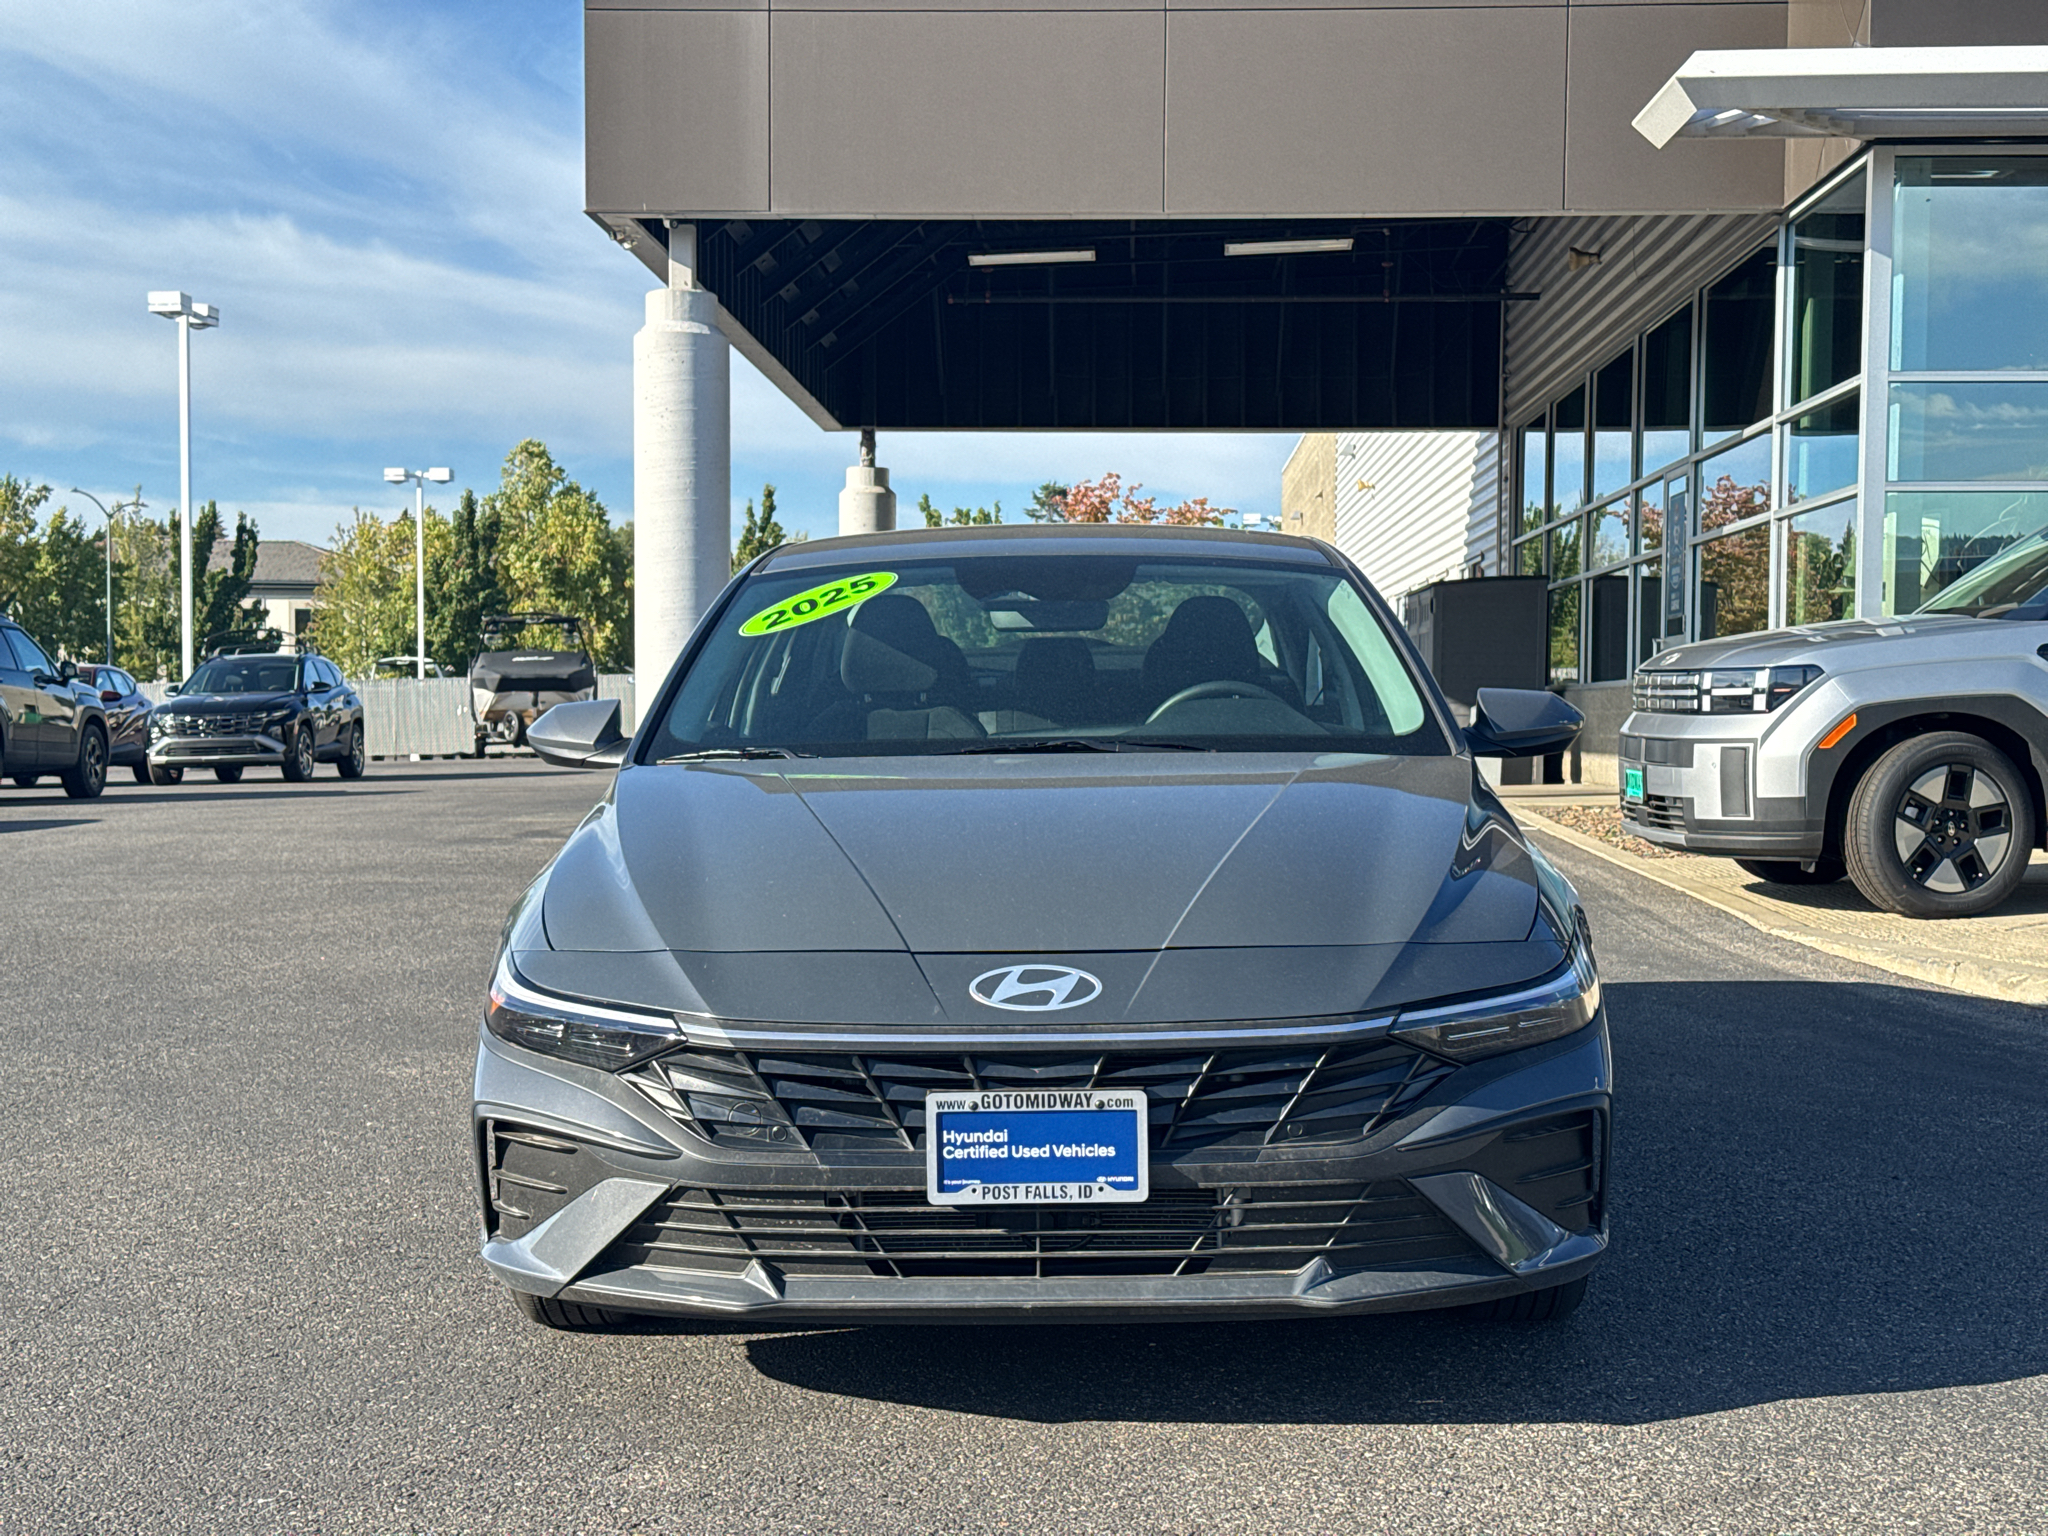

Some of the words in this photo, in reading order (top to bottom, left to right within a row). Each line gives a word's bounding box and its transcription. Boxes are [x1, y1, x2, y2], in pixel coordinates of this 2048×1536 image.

[762, 576, 877, 630] 2025
[980, 1093, 1093, 1109] GOTOMIDWAY
[1107, 1098, 1134, 1108] com
[942, 1129, 1008, 1146] Hyundai
[942, 1145, 1008, 1159] Certified
[1011, 1145, 1050, 1158] Used
[1052, 1143, 1116, 1157] Vehicles
[982, 1186, 1019, 1200] POST
[1025, 1185, 1073, 1201] FALLS,
[1078, 1185, 1093, 1199] ID
